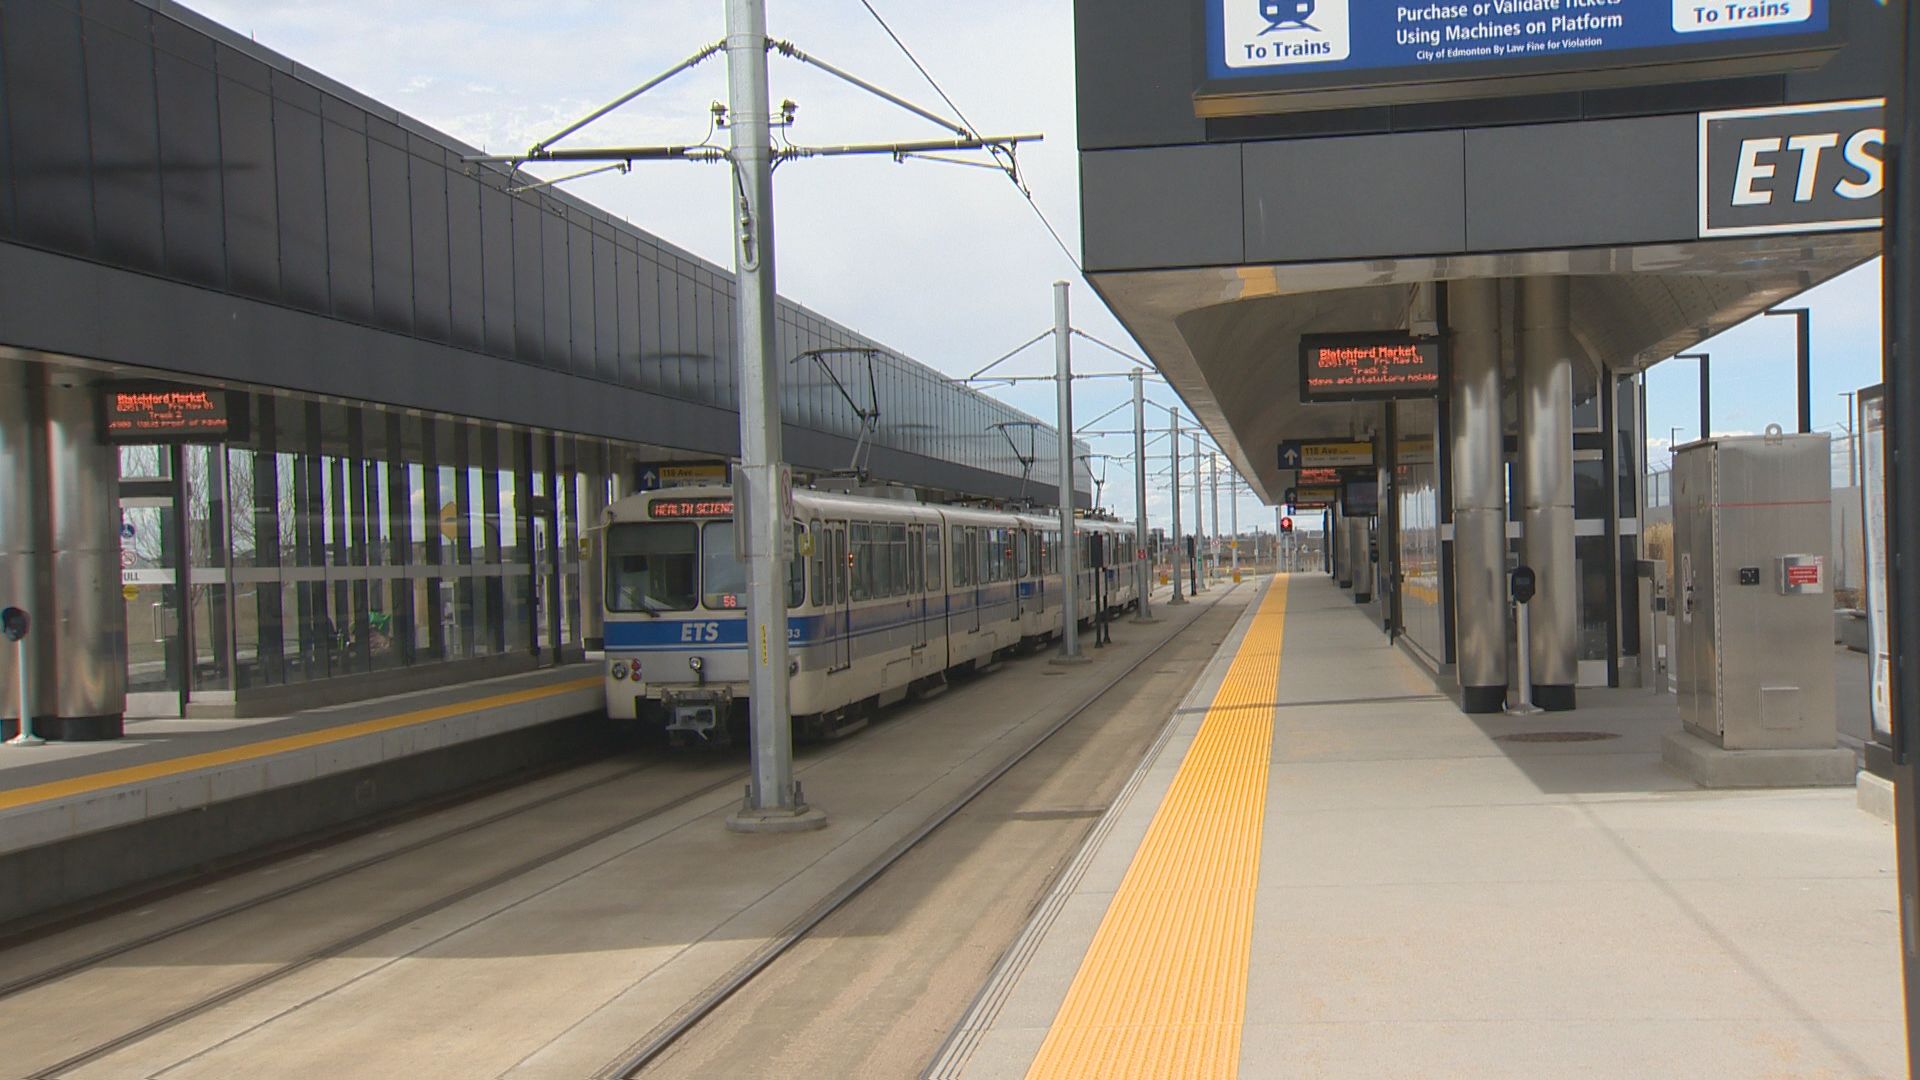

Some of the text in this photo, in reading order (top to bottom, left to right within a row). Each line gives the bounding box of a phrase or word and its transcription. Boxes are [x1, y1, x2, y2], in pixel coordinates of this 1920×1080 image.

[1397, 6, 1467, 22] Purchase
[1473, 4, 1490, 15] or
[1494, 0, 1559, 14] Validate
[1693, 3, 1790, 23] To Trains
[1396, 13, 1623, 45] Using Machines on Platform
[1244, 39, 1331, 60] To Trains
[1416, 37, 1602, 61] City of Edmonton By Law Fine for Violation
[1731, 128, 1884, 206] ETS
[1319, 345, 1416, 360] Blatchford Market
[1352, 367, 1379, 375] Track
[172, 391, 206, 403] Market
[1322, 446, 1338, 455] Ave
[677, 468, 692, 477] Ave
[655, 503, 694, 516] HEALTH
[723, 594, 737, 608] 56
[681, 622, 719, 642] ETS
